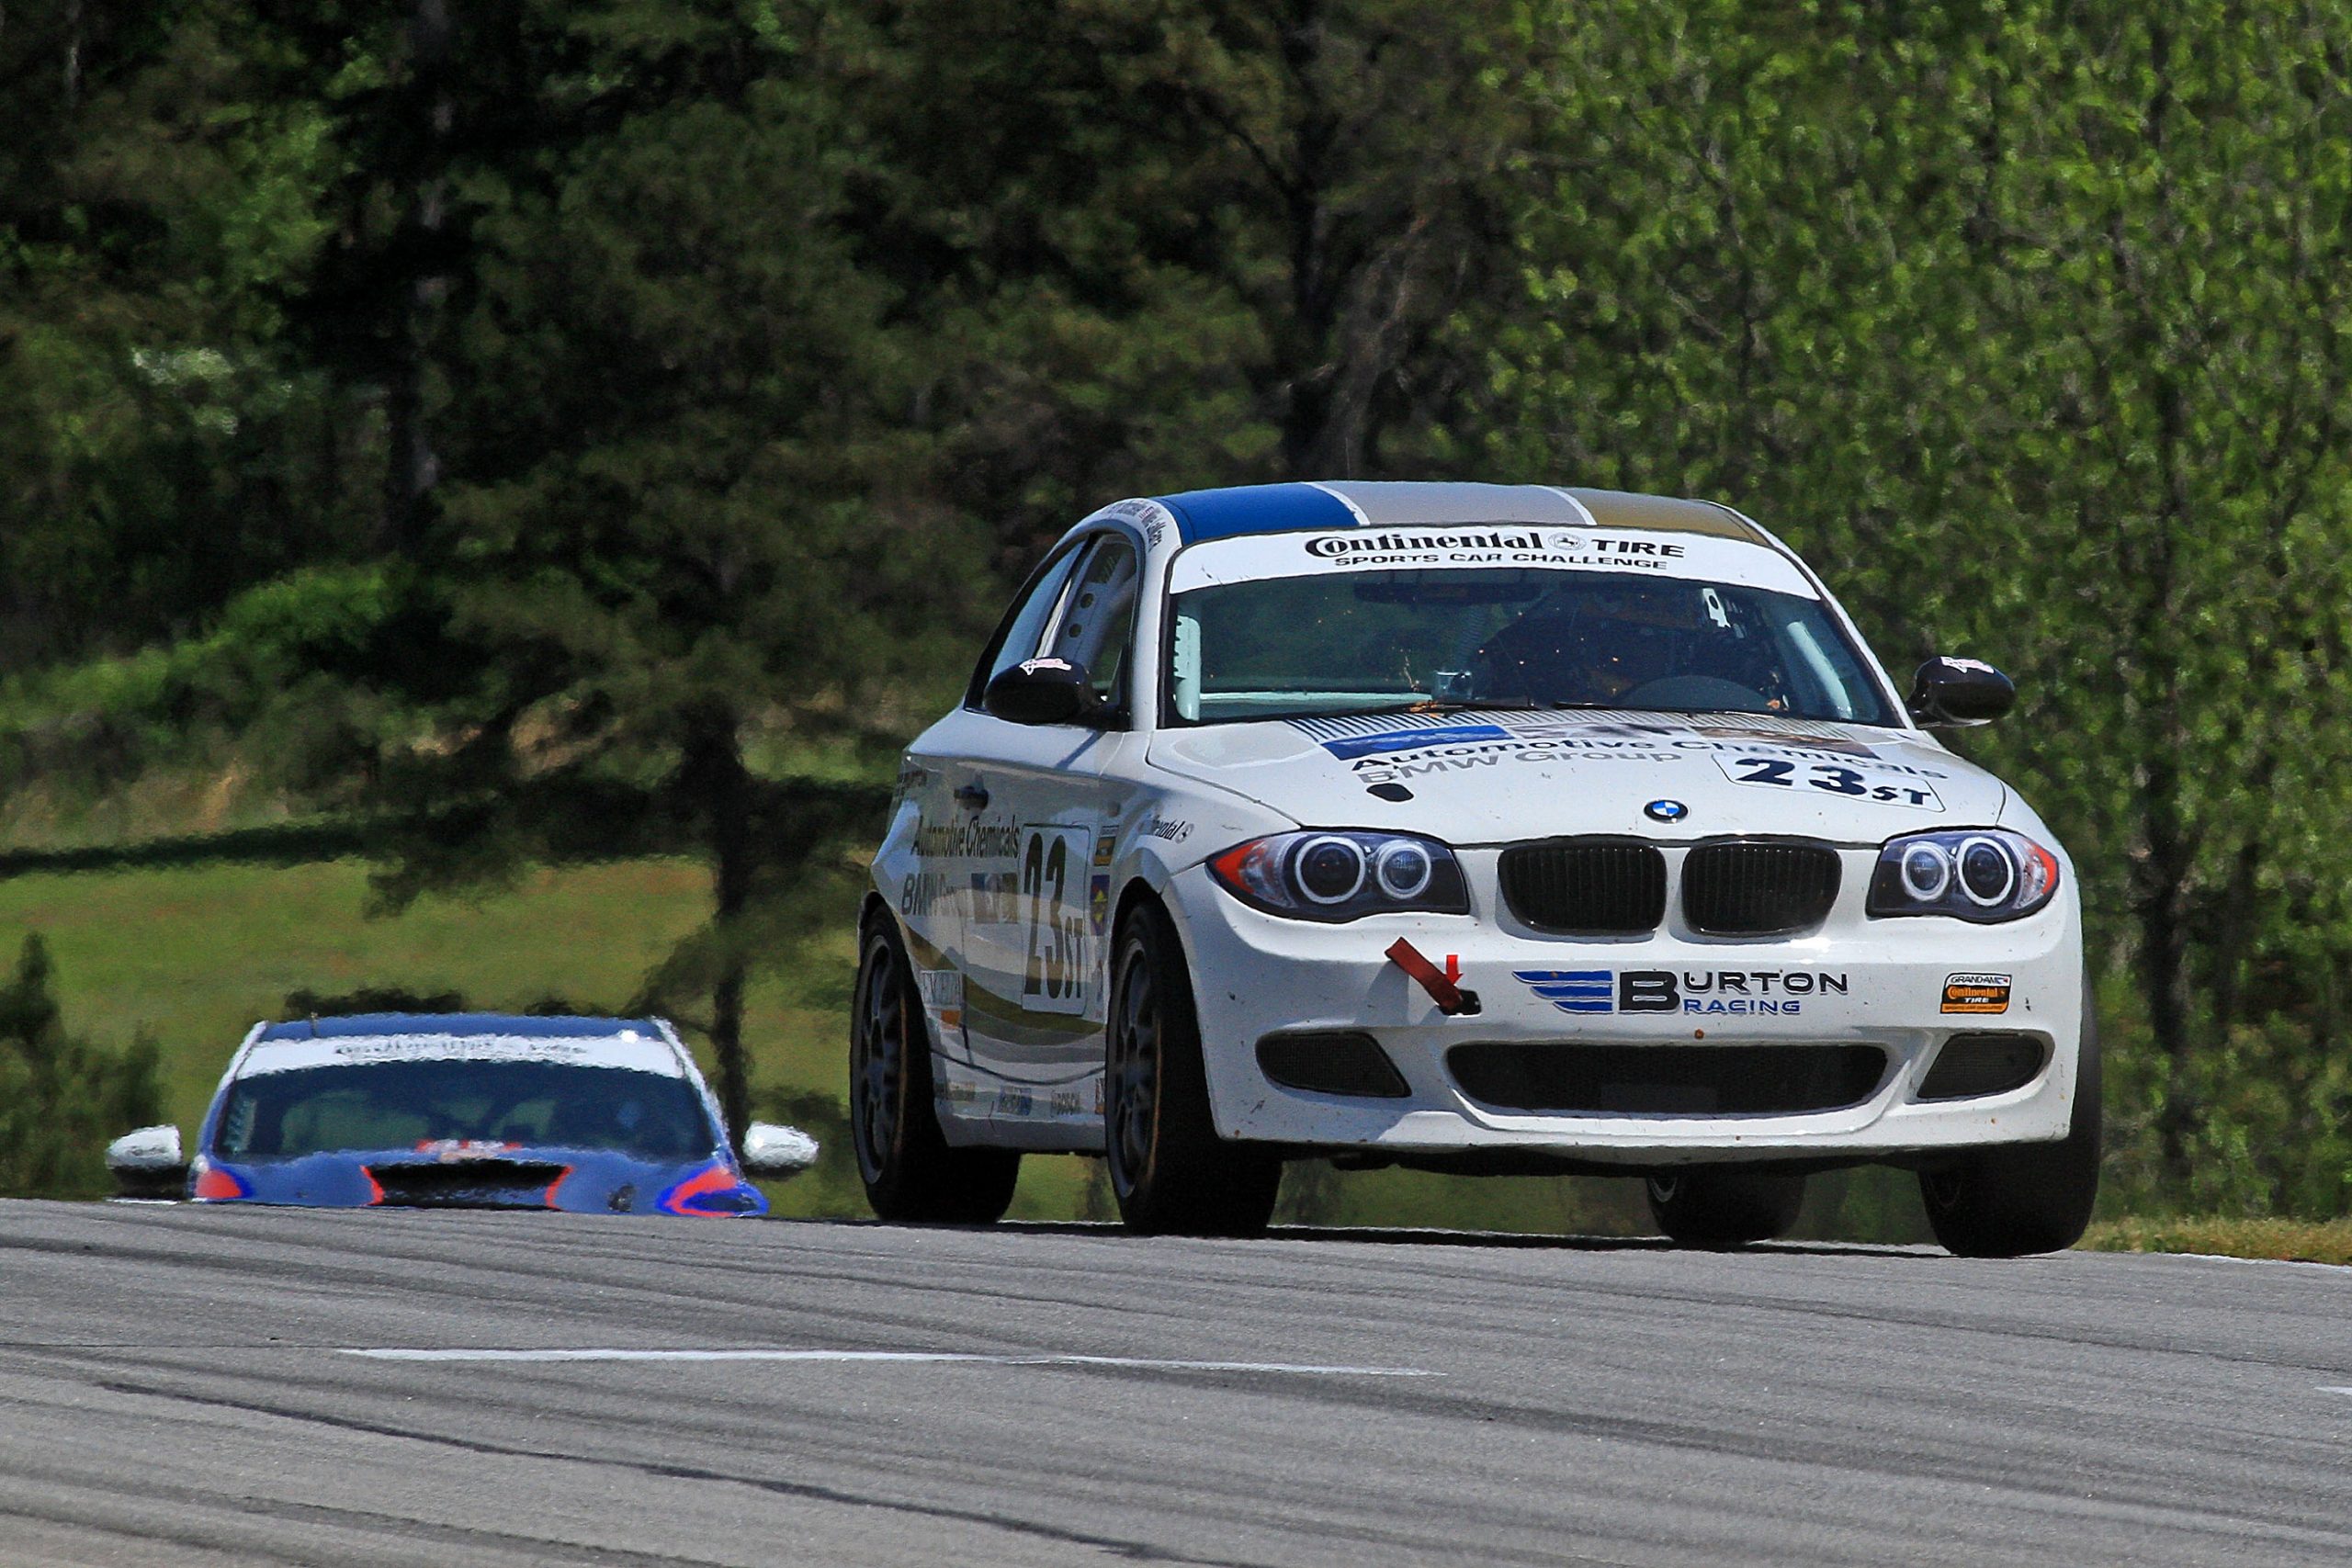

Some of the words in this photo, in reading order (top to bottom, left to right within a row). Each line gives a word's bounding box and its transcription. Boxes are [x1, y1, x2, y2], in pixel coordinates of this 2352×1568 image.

[1305, 532, 1544, 558] Continental
[1591, 538, 1685, 558] TIRE
[1335, 553, 1439, 566] SPORTS
[1449, 552, 1504, 562] CAR
[1512, 553, 1668, 570] CHALLENGE
[1351, 739, 1657, 771] Automotive
[1671, 740, 1949, 779] Chemicals
[1356, 754, 1499, 784] BMW
[1515, 750, 1683, 762] Group
[1619, 970, 1848, 1011] BURTON
[1683, 998, 1801, 1014] RACING
